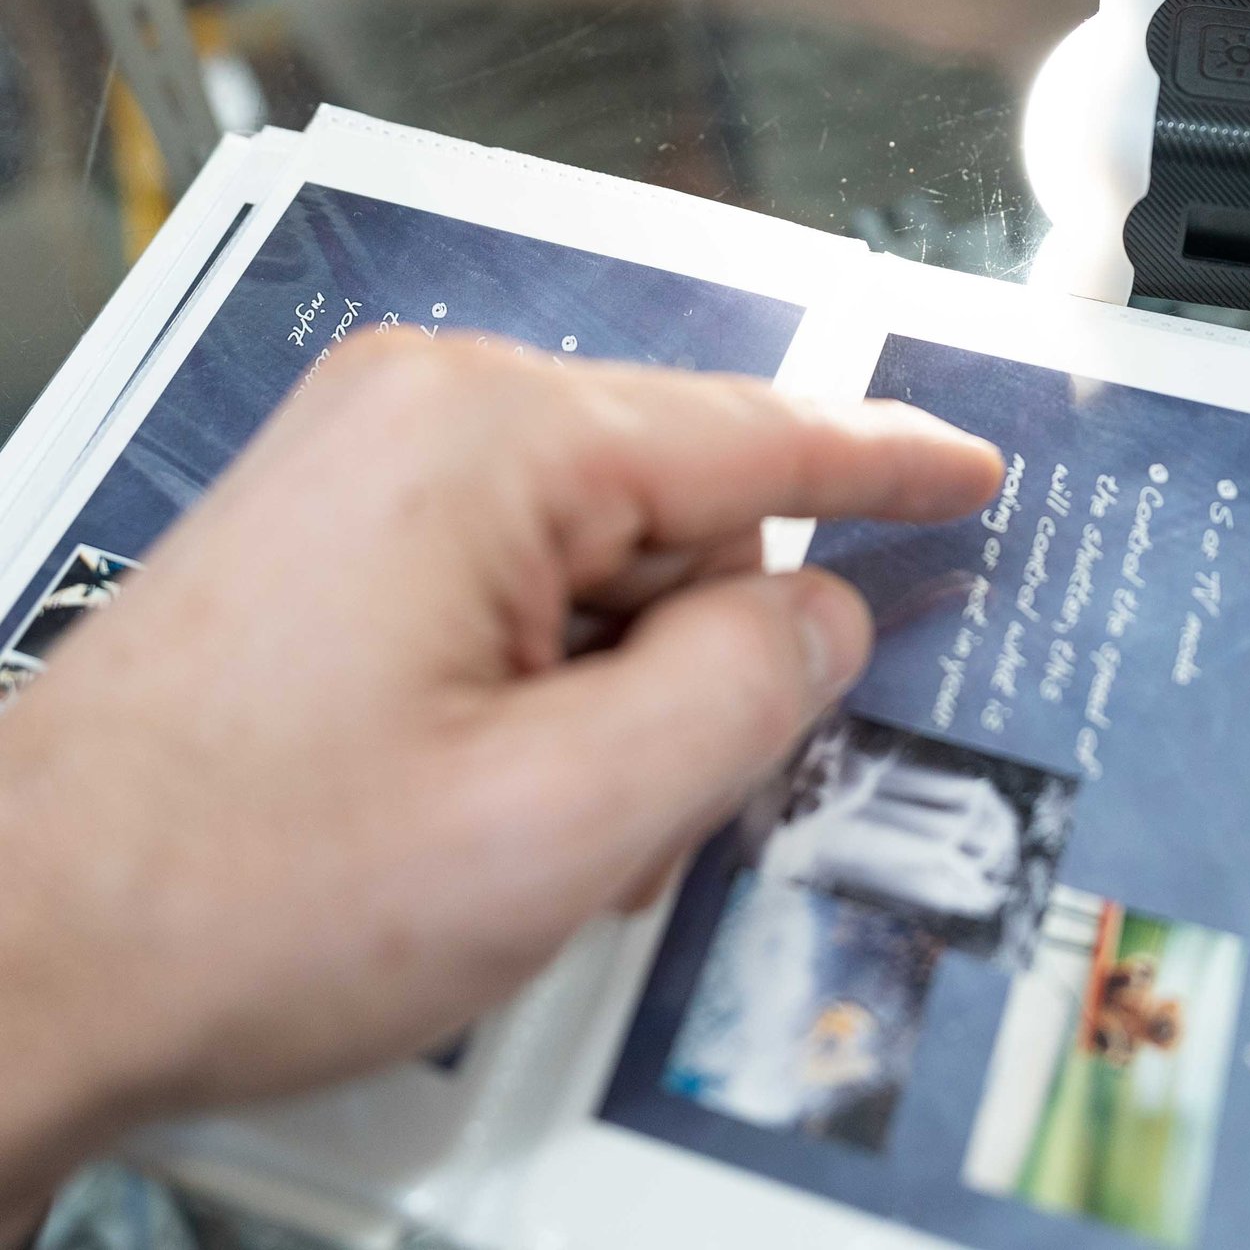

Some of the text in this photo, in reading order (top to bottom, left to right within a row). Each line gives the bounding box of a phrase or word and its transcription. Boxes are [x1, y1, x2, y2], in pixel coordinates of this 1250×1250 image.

[287, 292, 326, 347] night
[330, 298, 363, 343] you
[980, 453, 1026, 535] moving
[1046, 463, 1073, 517] will
[1089, 474, 1120, 519] the
[1121, 486, 1164, 589] Control
[1015, 516, 1056, 623] control
[1105, 588, 1139, 637] the
